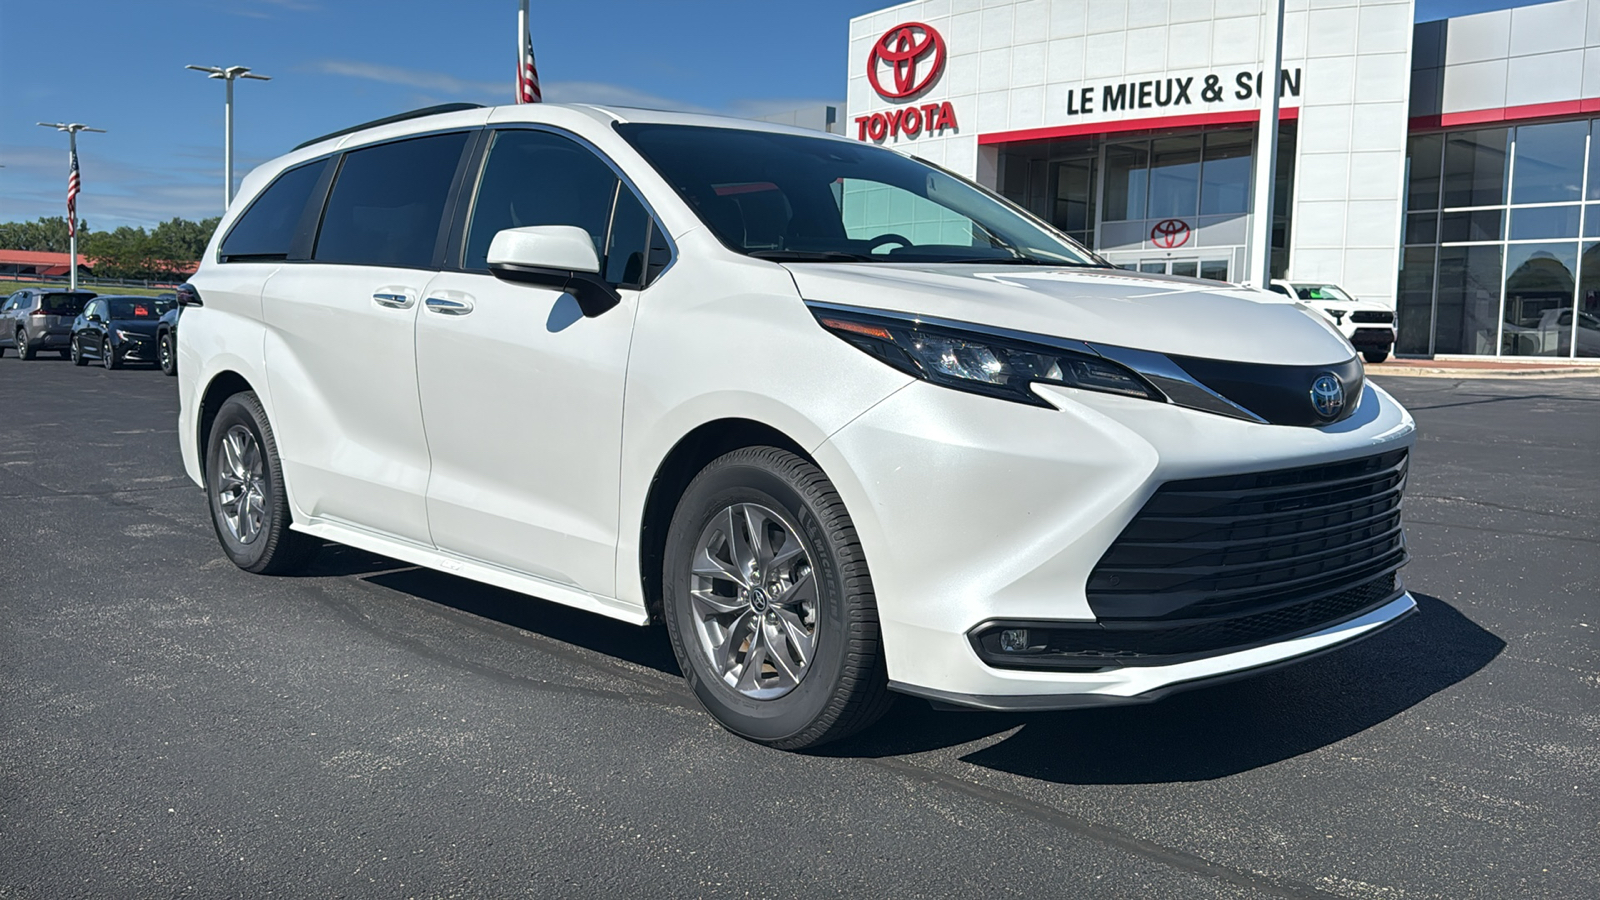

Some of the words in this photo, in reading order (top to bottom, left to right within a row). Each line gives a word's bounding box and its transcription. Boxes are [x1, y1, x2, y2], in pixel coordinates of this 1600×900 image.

[1067, 87, 1094, 115] LE
[1102, 77, 1194, 112] MIEUX
[1201, 74, 1223, 102] &
[1235, 68, 1301, 100] SN
[855, 101, 958, 142] TOYOTA
[814, 540, 838, 617] MICHELIN
